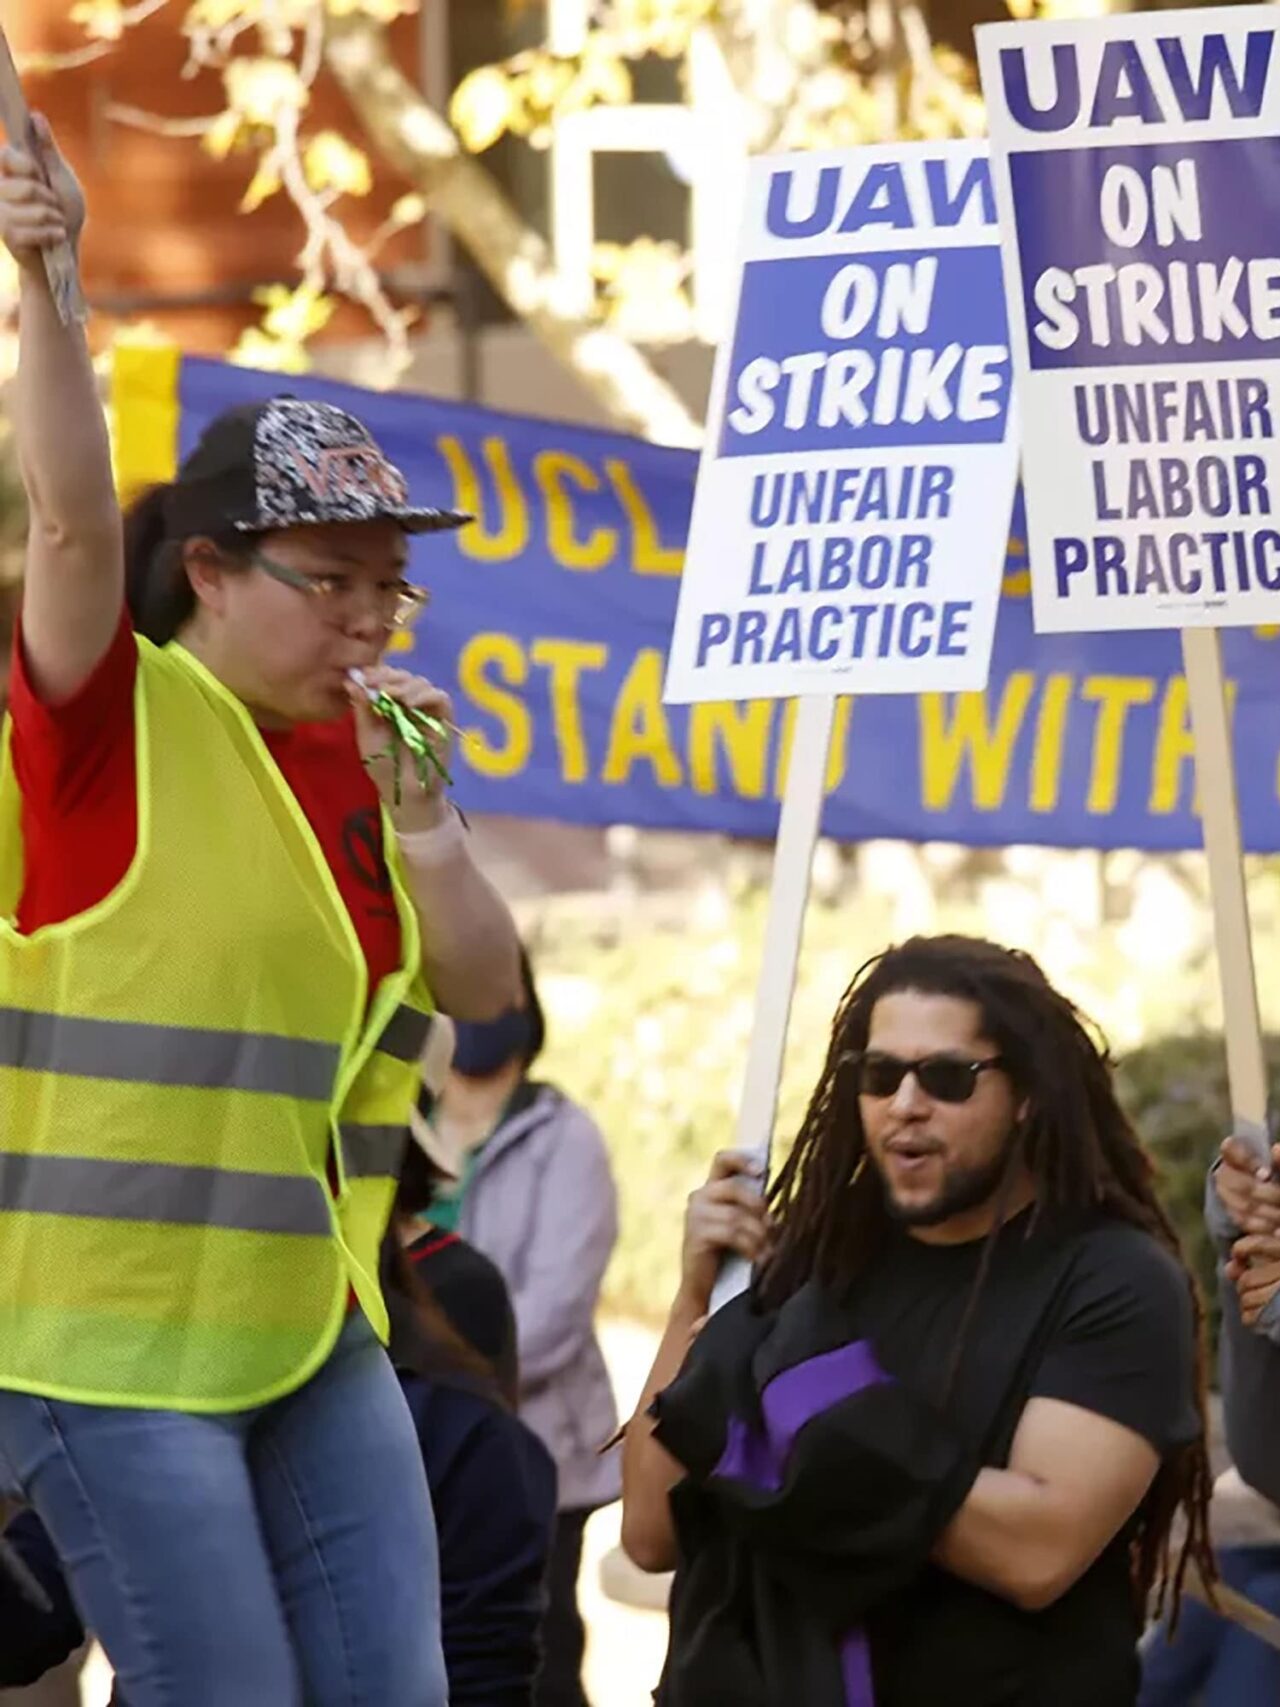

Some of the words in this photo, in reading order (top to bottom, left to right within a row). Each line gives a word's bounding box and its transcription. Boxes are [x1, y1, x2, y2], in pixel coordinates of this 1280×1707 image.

[1000, 30, 1276, 133] UAW
[764, 157, 1000, 239] UAW
[1099, 159, 1202, 247] ON
[821, 257, 938, 340] ON
[729, 344, 1009, 435] STRIKE
[1074, 377, 1274, 446] UNFAIR
[437, 434, 687, 577] UCL
[749, 464, 955, 529] UNFAIR
[1091, 454, 1271, 521] LABOR
[747, 534, 934, 596] LABOR
[694, 600, 975, 669] PRACTICE
